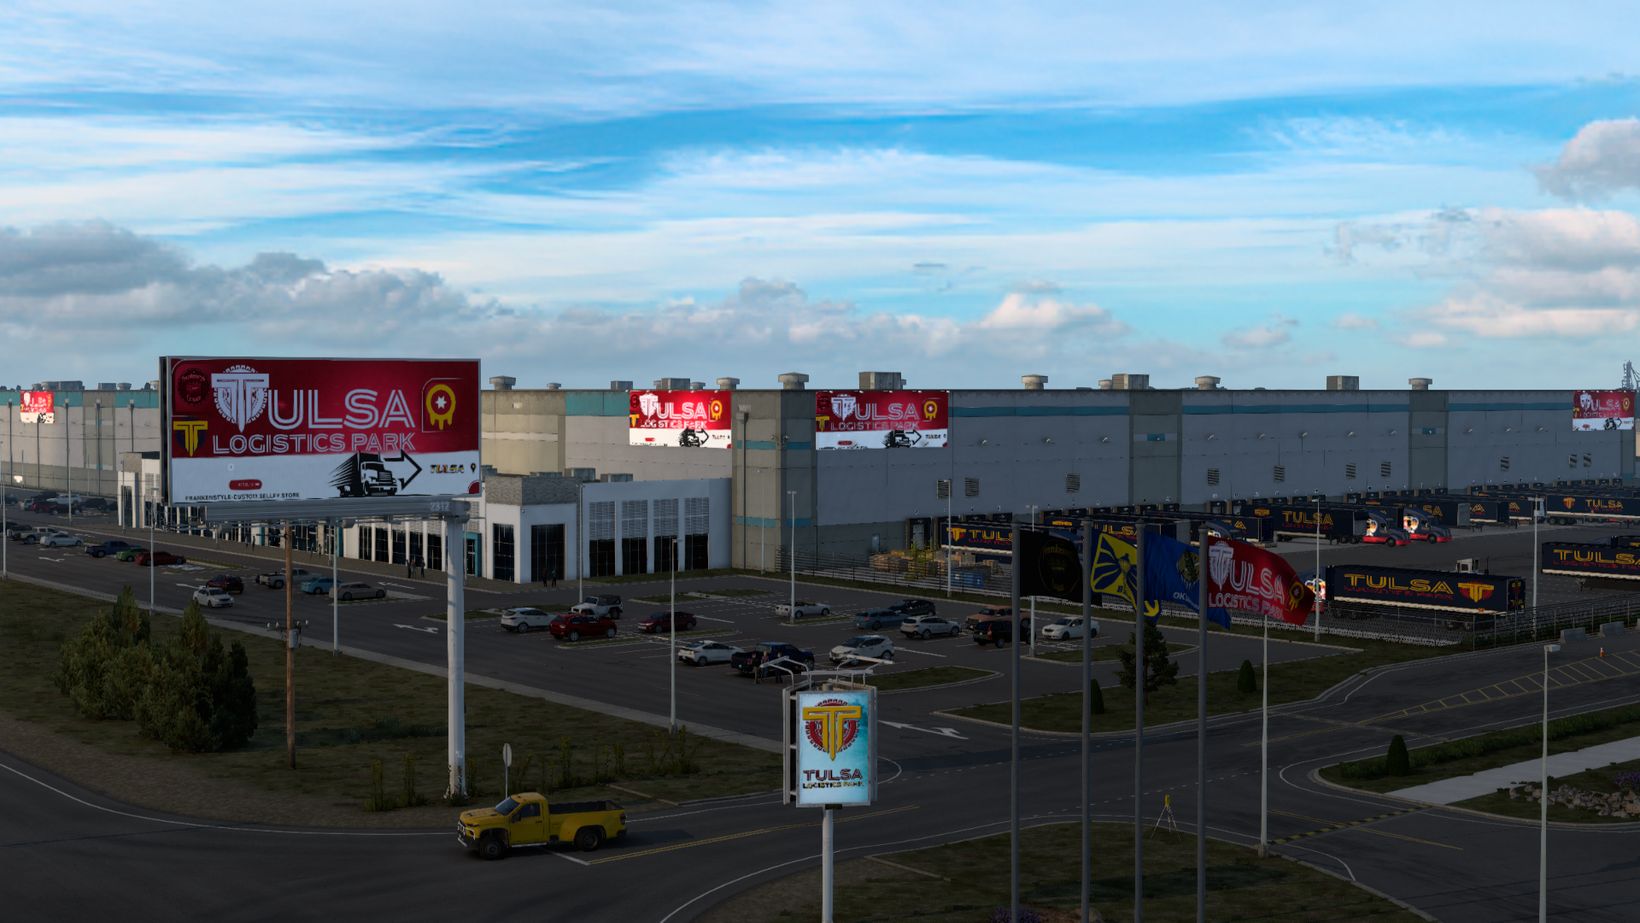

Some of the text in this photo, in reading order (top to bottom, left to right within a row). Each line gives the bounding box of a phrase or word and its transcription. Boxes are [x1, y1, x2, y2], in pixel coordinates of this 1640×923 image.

[212, 432, 416, 454] LOGISTICS PARK
[430, 464, 465, 473] TULSA
[1584, 498, 1624, 509] TULSA
[1282, 510, 1334, 525] TULSA
[1343, 573, 1454, 595] TULSA
[802, 768, 863, 781] TULSA
